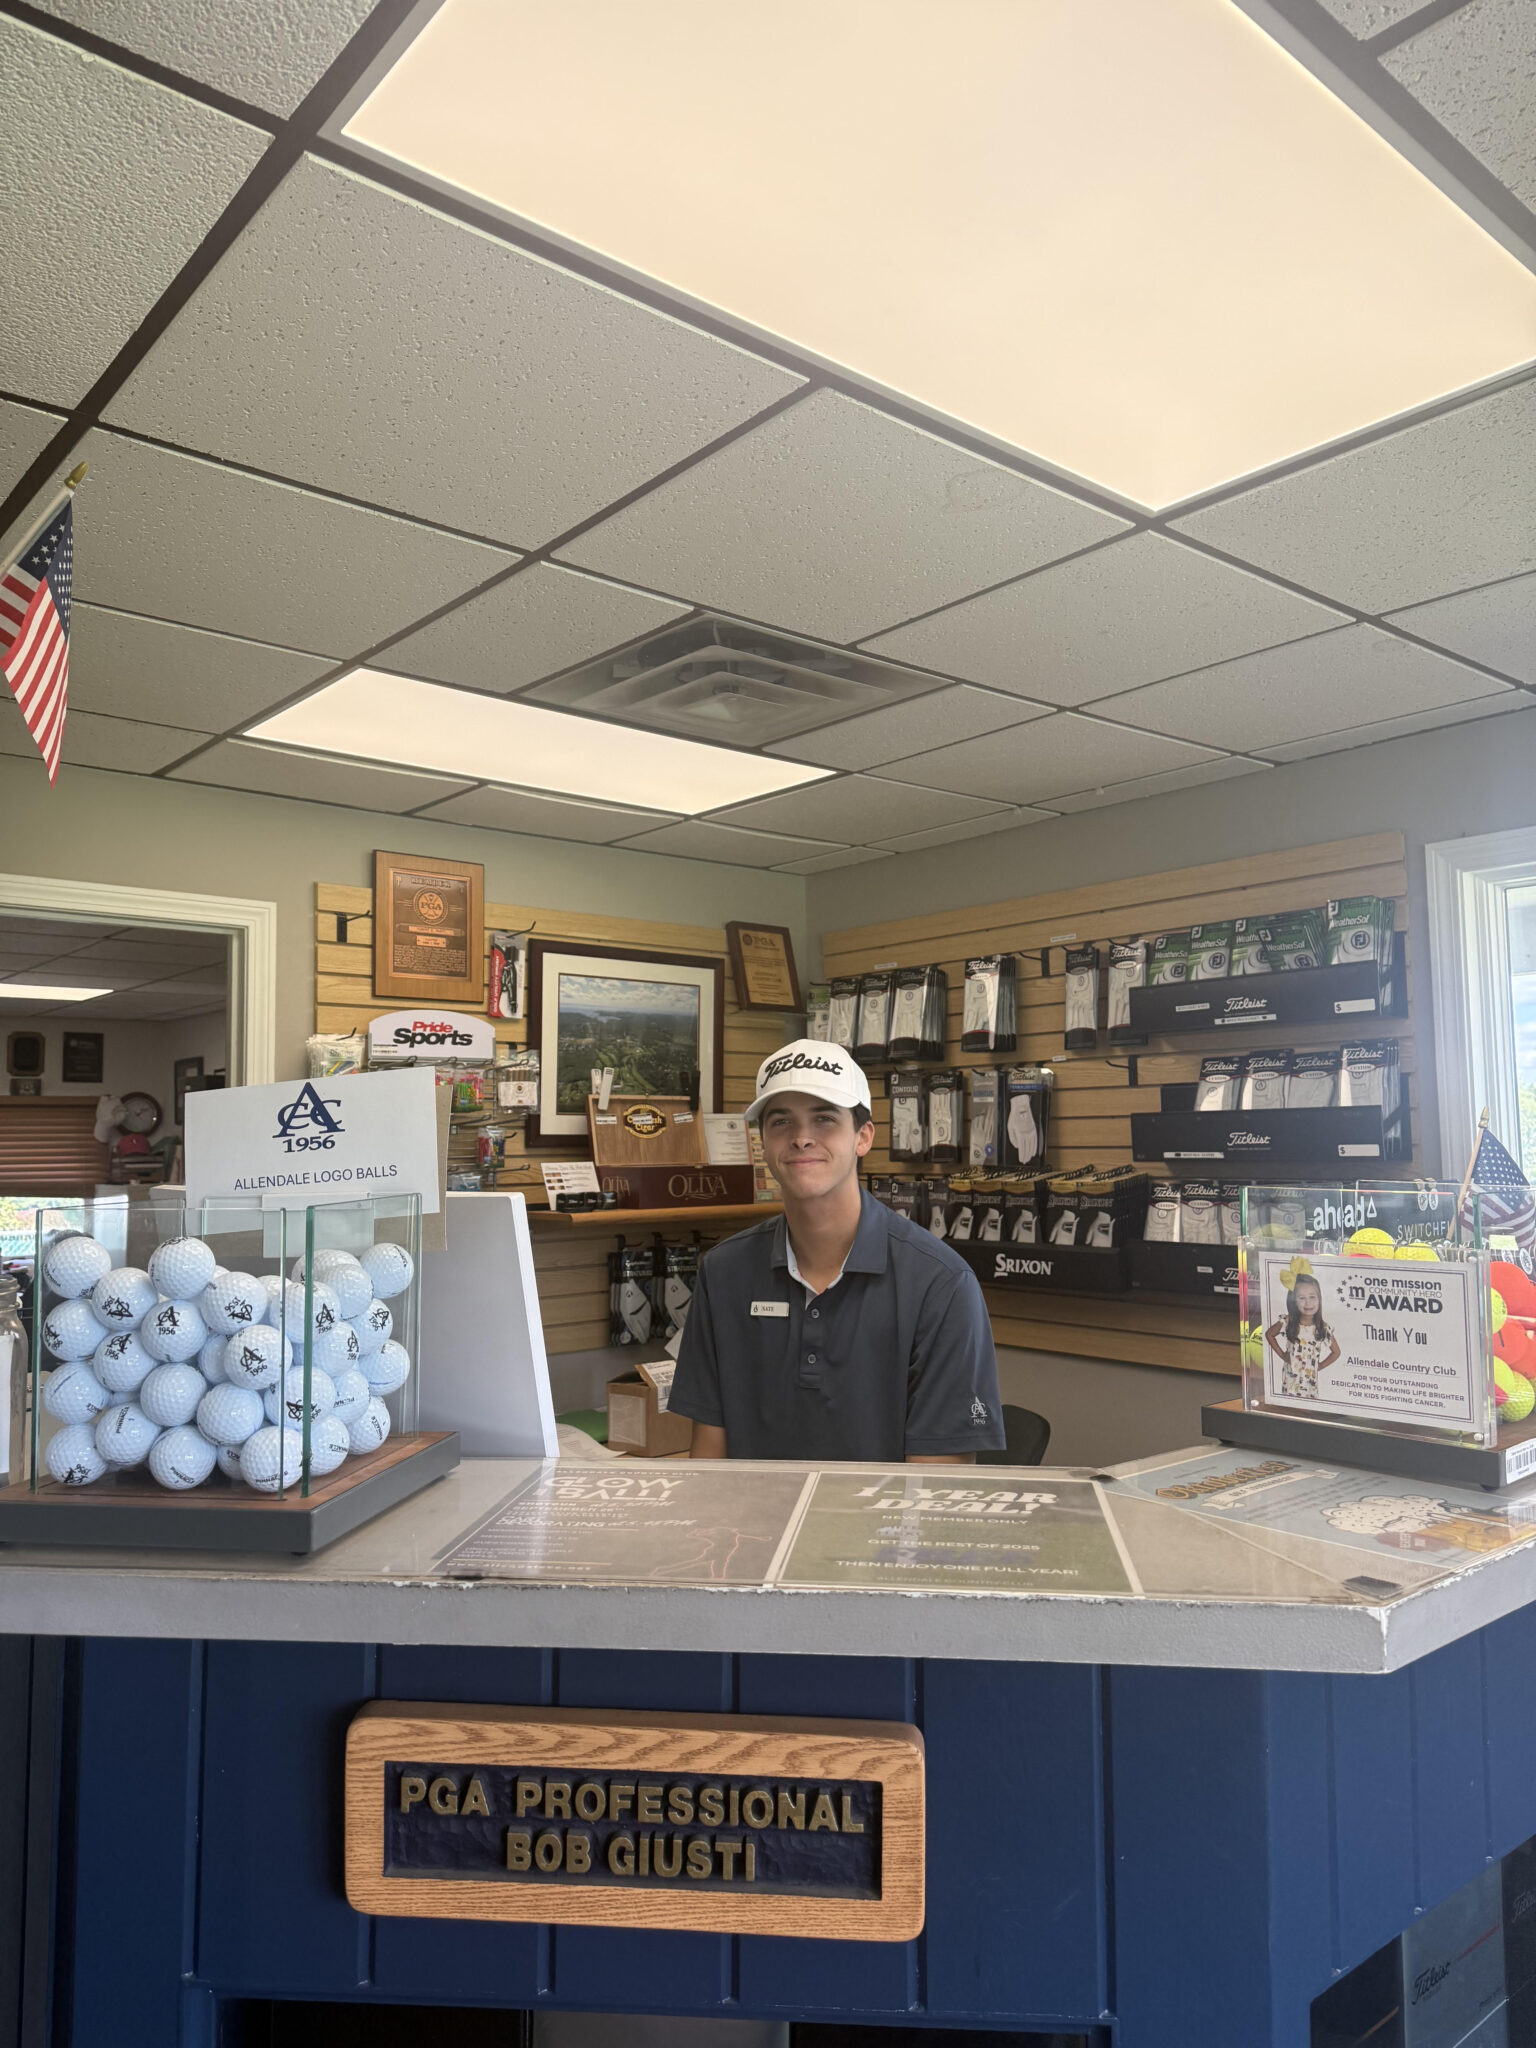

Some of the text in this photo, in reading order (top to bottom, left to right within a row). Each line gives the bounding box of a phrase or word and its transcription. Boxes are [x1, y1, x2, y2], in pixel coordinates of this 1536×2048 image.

[420, 902, 442, 911] PGA
[1191, 938, 1228, 950] WeatherSof
[1266, 941, 1305, 952] WeatherSof
[968, 960, 997, 971] Titleist
[1223, 996, 1268, 1012] Titleist
[1336, 1003, 1342, 1013] $
[412, 1021, 453, 1033] Pride
[392, 1028, 473, 1048] Sports
[1341, 1048, 1384, 1061] Titleist
[1201, 1060, 1239, 1072] Titleist
[1246, 1057, 1288, 1069] Titleist
[1293, 1057, 1335, 1069] Titleist
[760, 1053, 843, 1089] Titleist
[891, 1085, 919, 1094] CONTOUR
[282, 1135, 336, 1153] 1956
[1227, 1132, 1271, 1146] Titleist
[234, 1164, 398, 1190] ALLENDALE LOGO BALLS
[668, 1174, 728, 1198] OLIVA
[1183, 1183, 1220, 1196] Titleist
[1313, 1195, 1365, 1232] ahead
[994, 1253, 1052, 1278] SRIXON
[1364, 1277, 1442, 1291] one mission
[1368, 1287, 1443, 1298] COMMUNITY HERO
[1365, 1294, 1443, 1314] AWARD
[158, 1327, 176, 1335] 1956
[1362, 1323, 1428, 1345] Thank You
[105, 1348, 119, 1360] 1956
[250, 1363, 268, 1377] 1956
[1346, 1356, 1457, 1376] Allendale Country Club
[1369, 1375, 1388, 1383] YOUR
[1389, 1377, 1439, 1389] OUTSTANDING
[1331, 1380, 1371, 1391] DEDICATION
[1383, 1386, 1410, 1395] MAKING
[1412, 1389, 1427, 1397] LIFE
[1429, 1391, 1465, 1402] BRIGHTER
[1364, 1392, 1380, 1400] KIDS
[1380, 1394, 1413, 1404] FIGHTING
[1414, 1397, 1446, 1408] CANCER.
[544, 1476, 684, 1488] GLOW
[872, 1498, 1040, 1514] DEAL!
[1028, 1568, 1079, 1576] YEAR!
[400, 1775, 865, 1833] PGA PROFESSIONAL
[506, 1831, 756, 1882] BOB GIUSTI
[1411, 1961, 1451, 2006] Titleist
